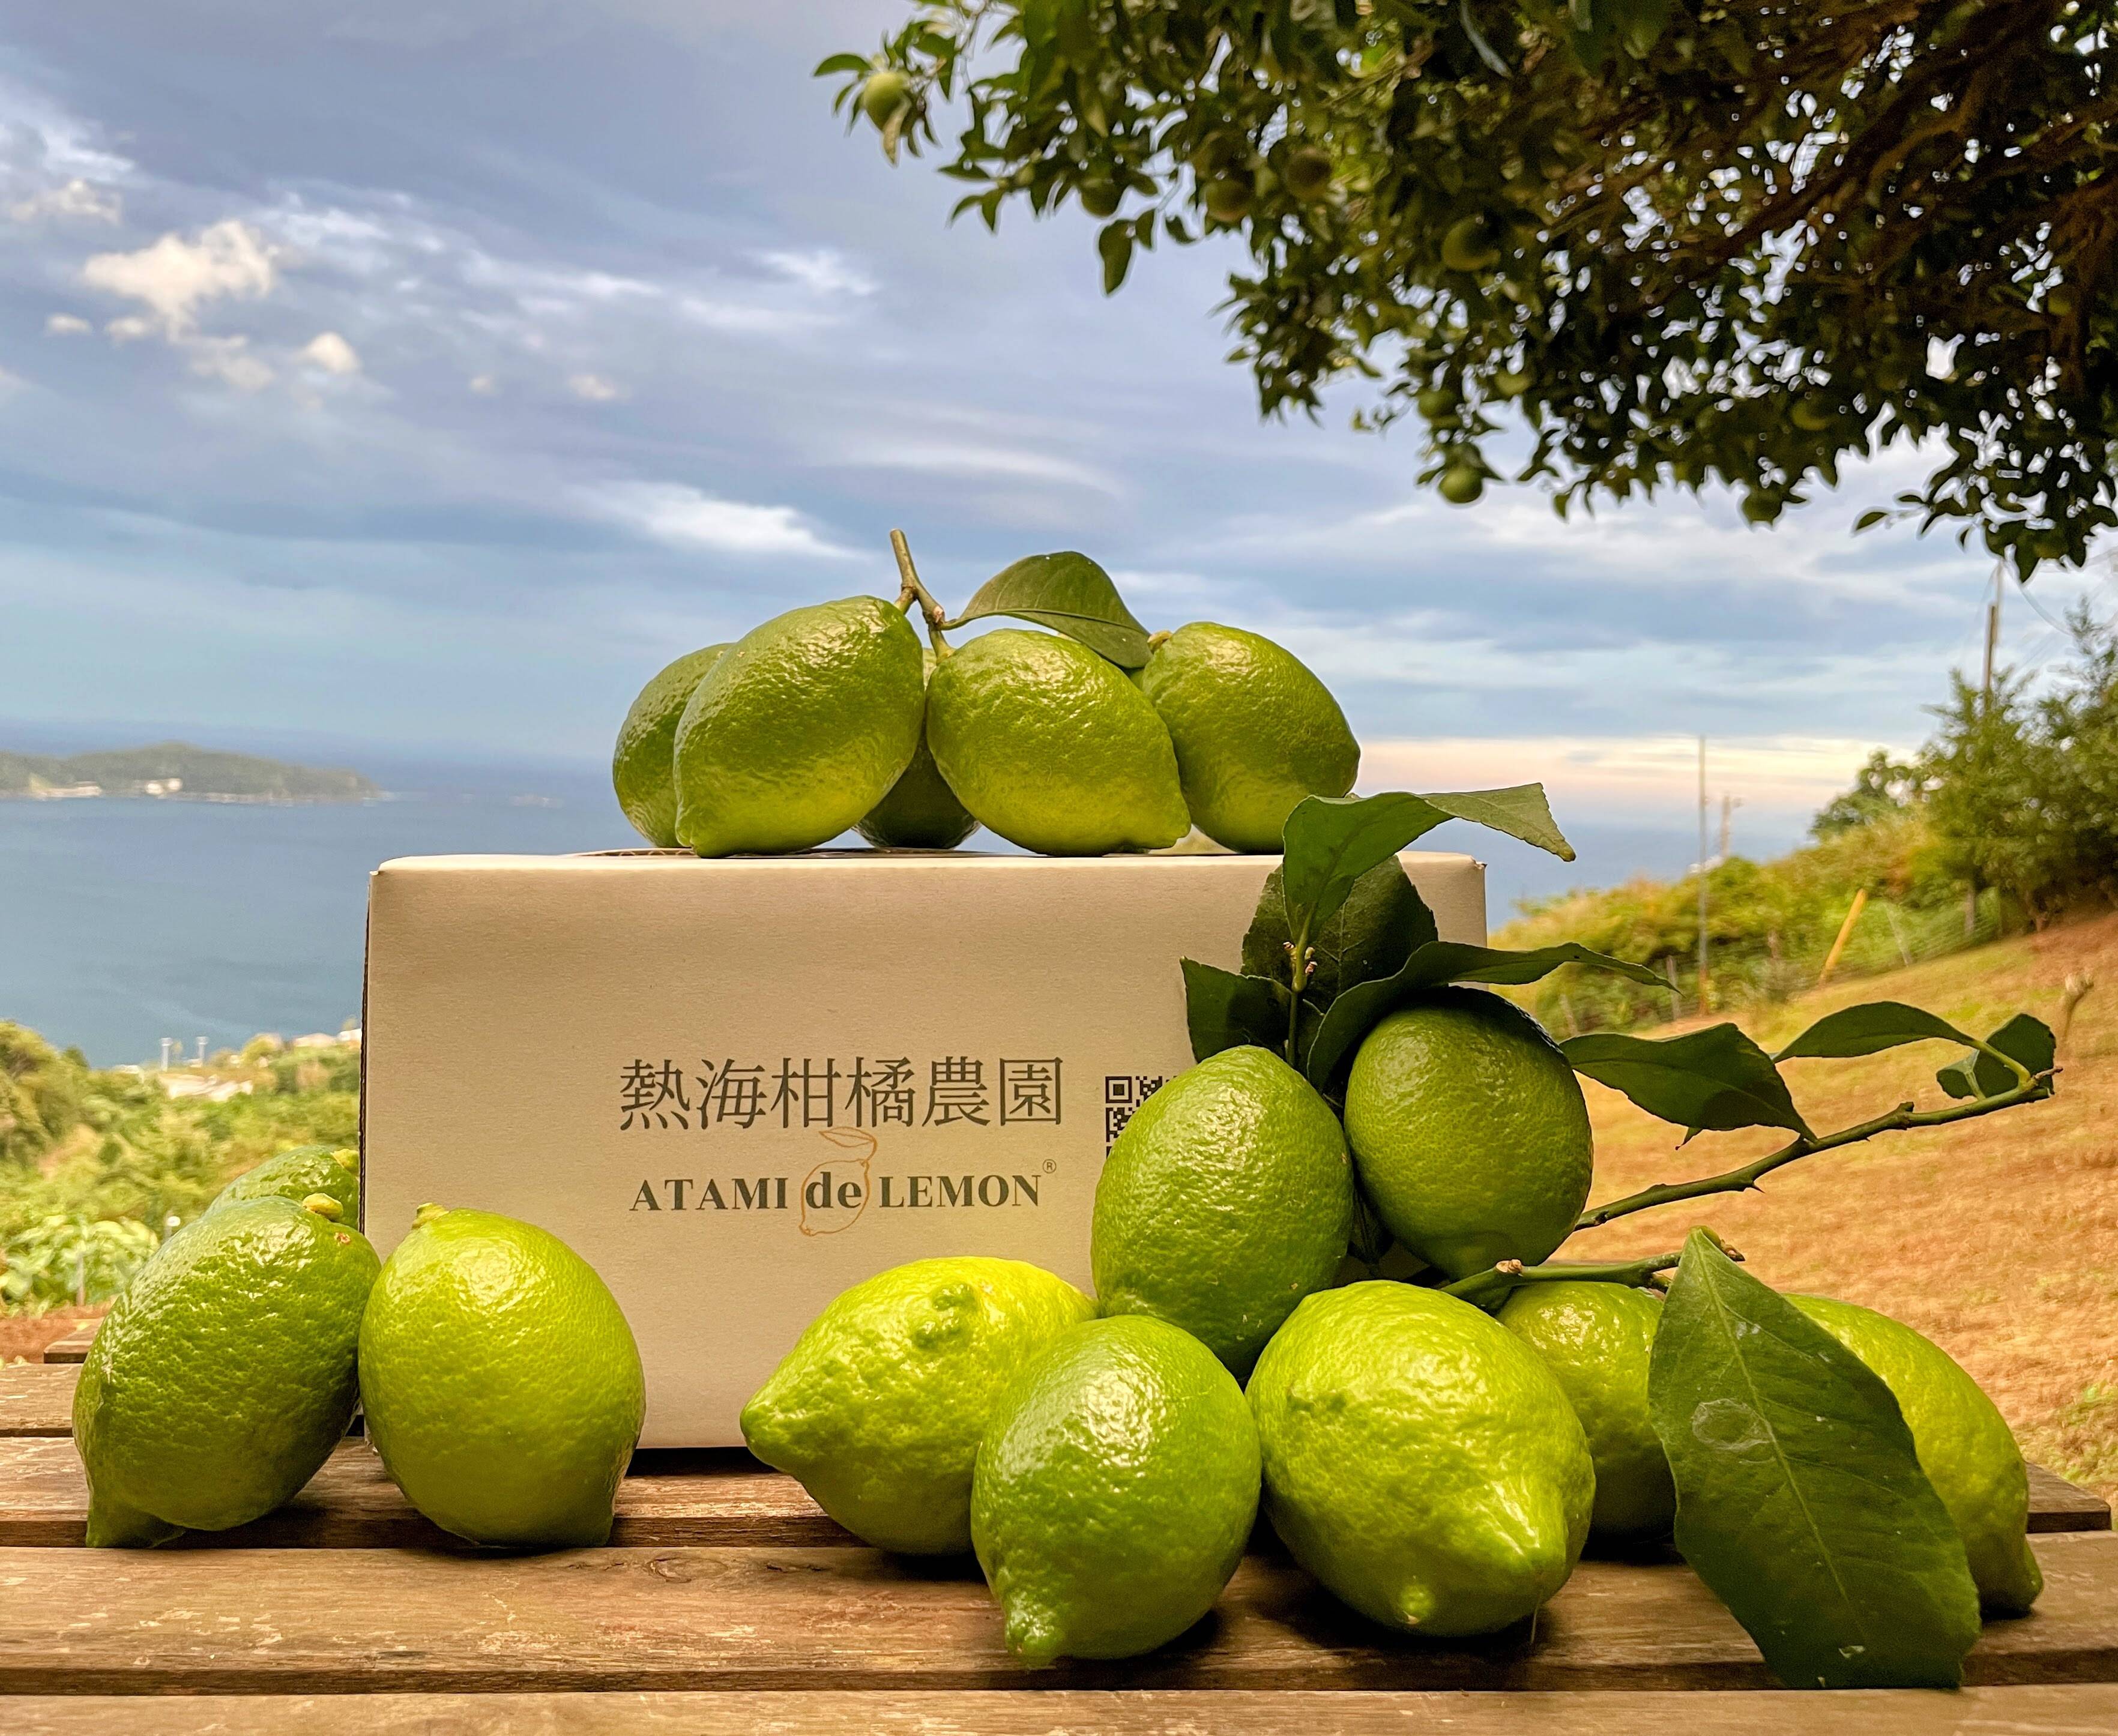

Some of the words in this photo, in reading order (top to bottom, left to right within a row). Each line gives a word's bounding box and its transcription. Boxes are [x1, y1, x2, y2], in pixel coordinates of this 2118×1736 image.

[620, 1056, 1063, 1131] 熱海柑橘農園
[629, 1177, 788, 1211] ATAMI
[805, 1171, 862, 1209] de
